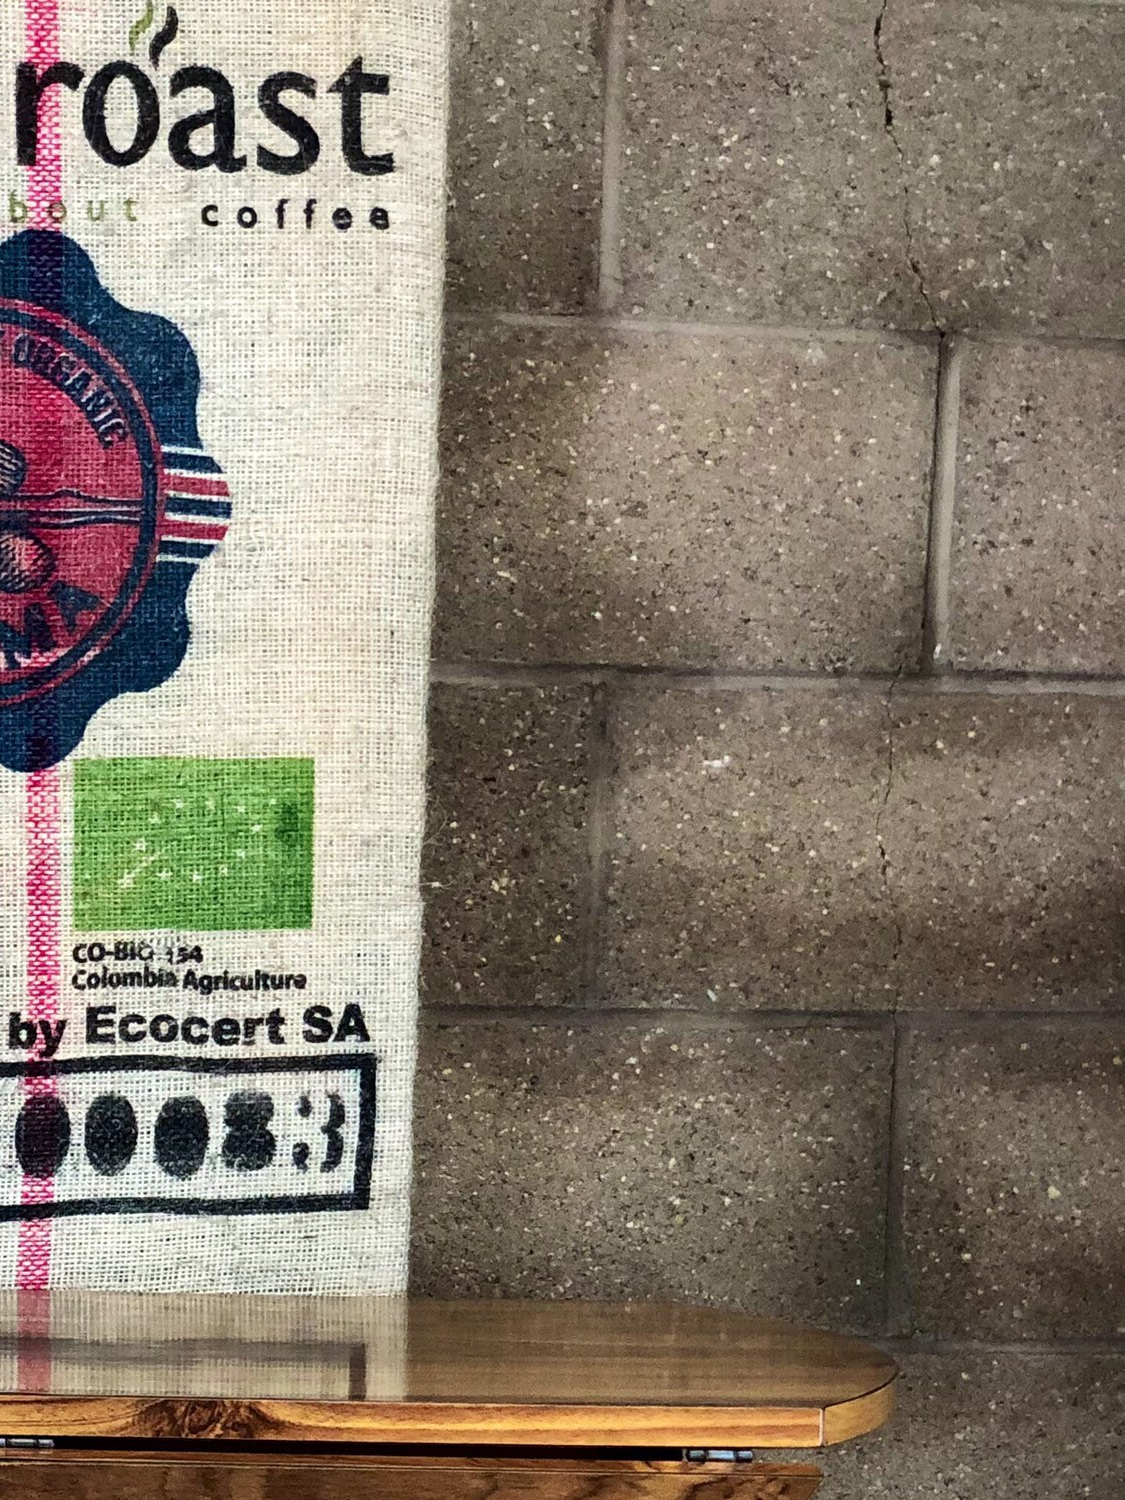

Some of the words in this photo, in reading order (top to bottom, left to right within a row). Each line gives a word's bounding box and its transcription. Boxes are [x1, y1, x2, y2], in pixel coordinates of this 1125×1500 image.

[201, 198, 390, 231] coffee
[71, 966, 176, 991] Colombia
[182, 969, 307, 995] Agriculture
[8, 1012, 67, 1057] by
[85, 1005, 286, 1046] Ecocert
[302, 1003, 371, 1043] SA
